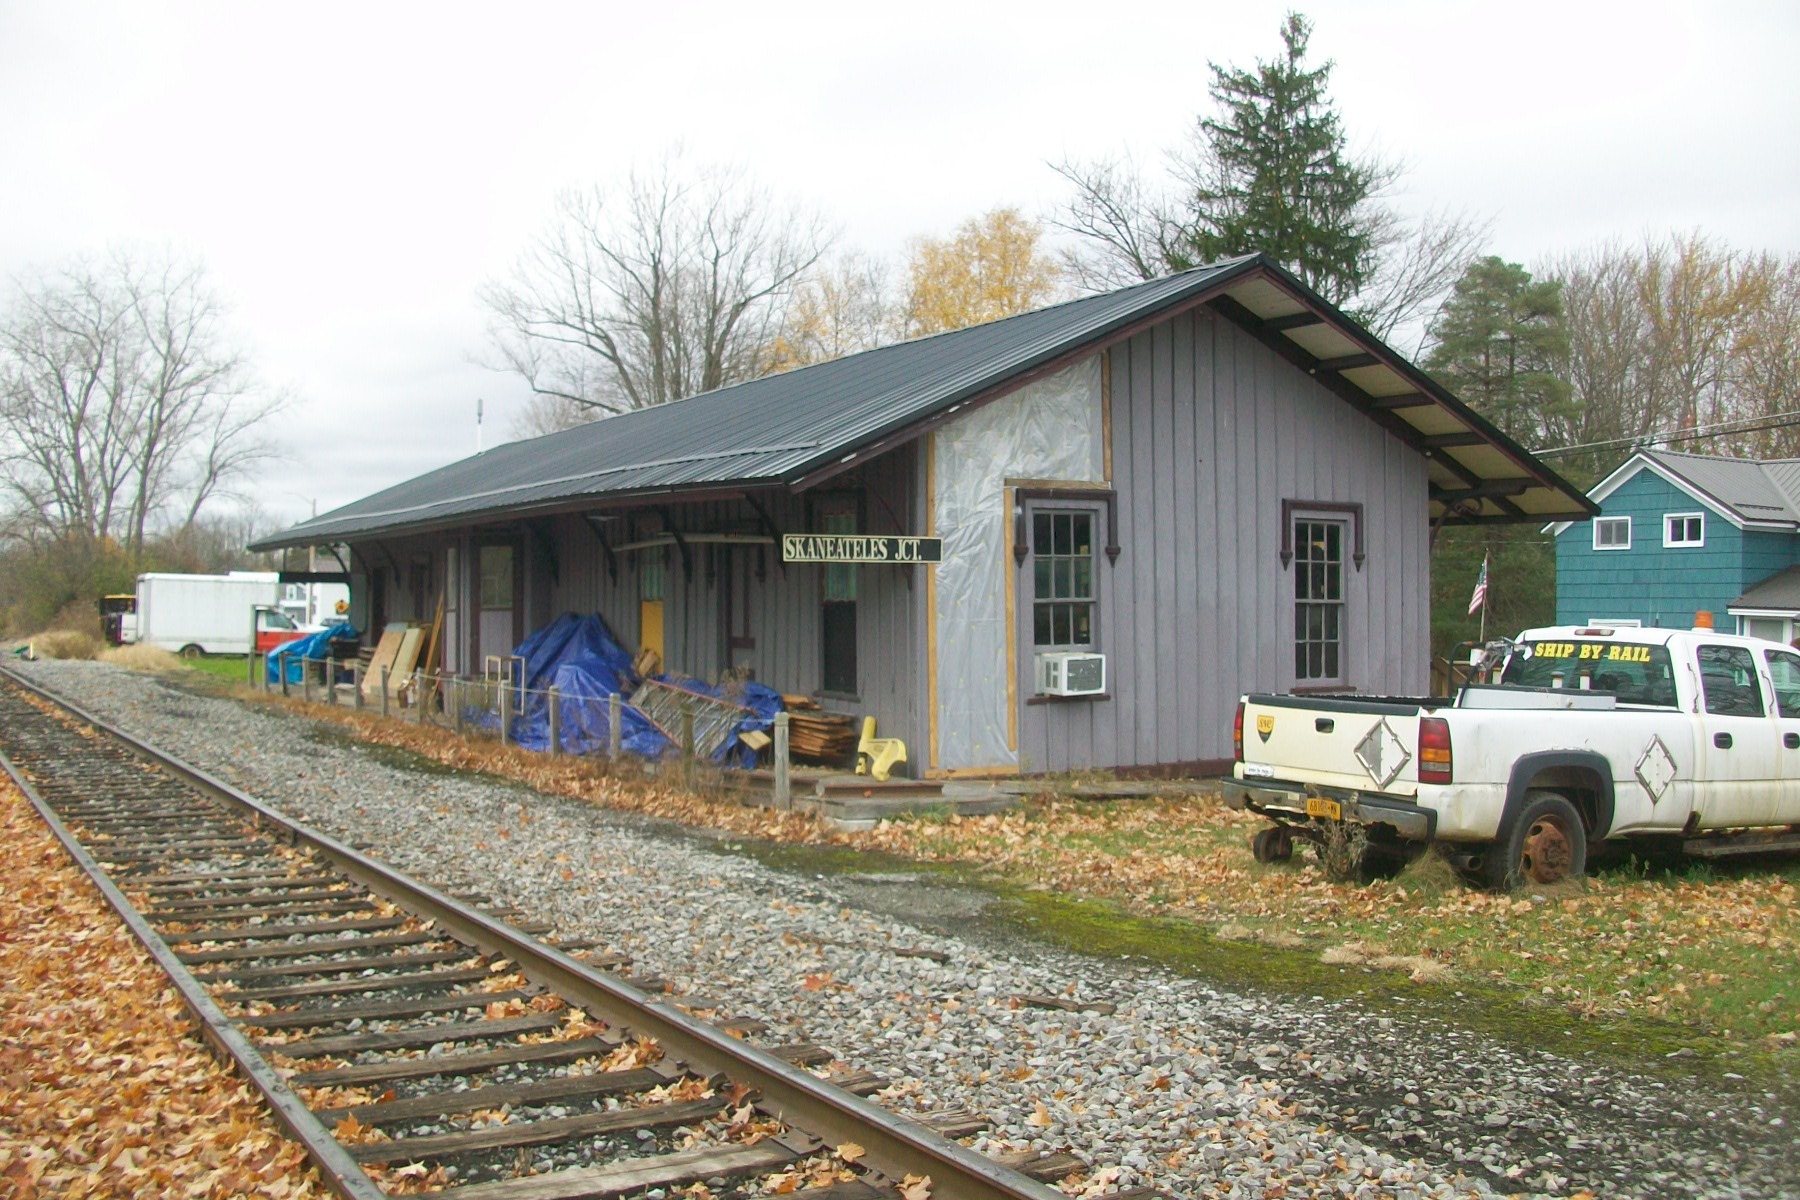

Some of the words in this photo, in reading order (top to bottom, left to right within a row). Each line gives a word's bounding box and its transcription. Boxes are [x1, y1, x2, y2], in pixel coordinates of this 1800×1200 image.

[785, 537, 888, 560] SKANEATELES
[895, 539, 922, 561] JCT.
[1534, 643, 1574, 658] SHIP
[1578, 644, 1603, 660] BY
[1608, 646, 1651, 663] RAIL
